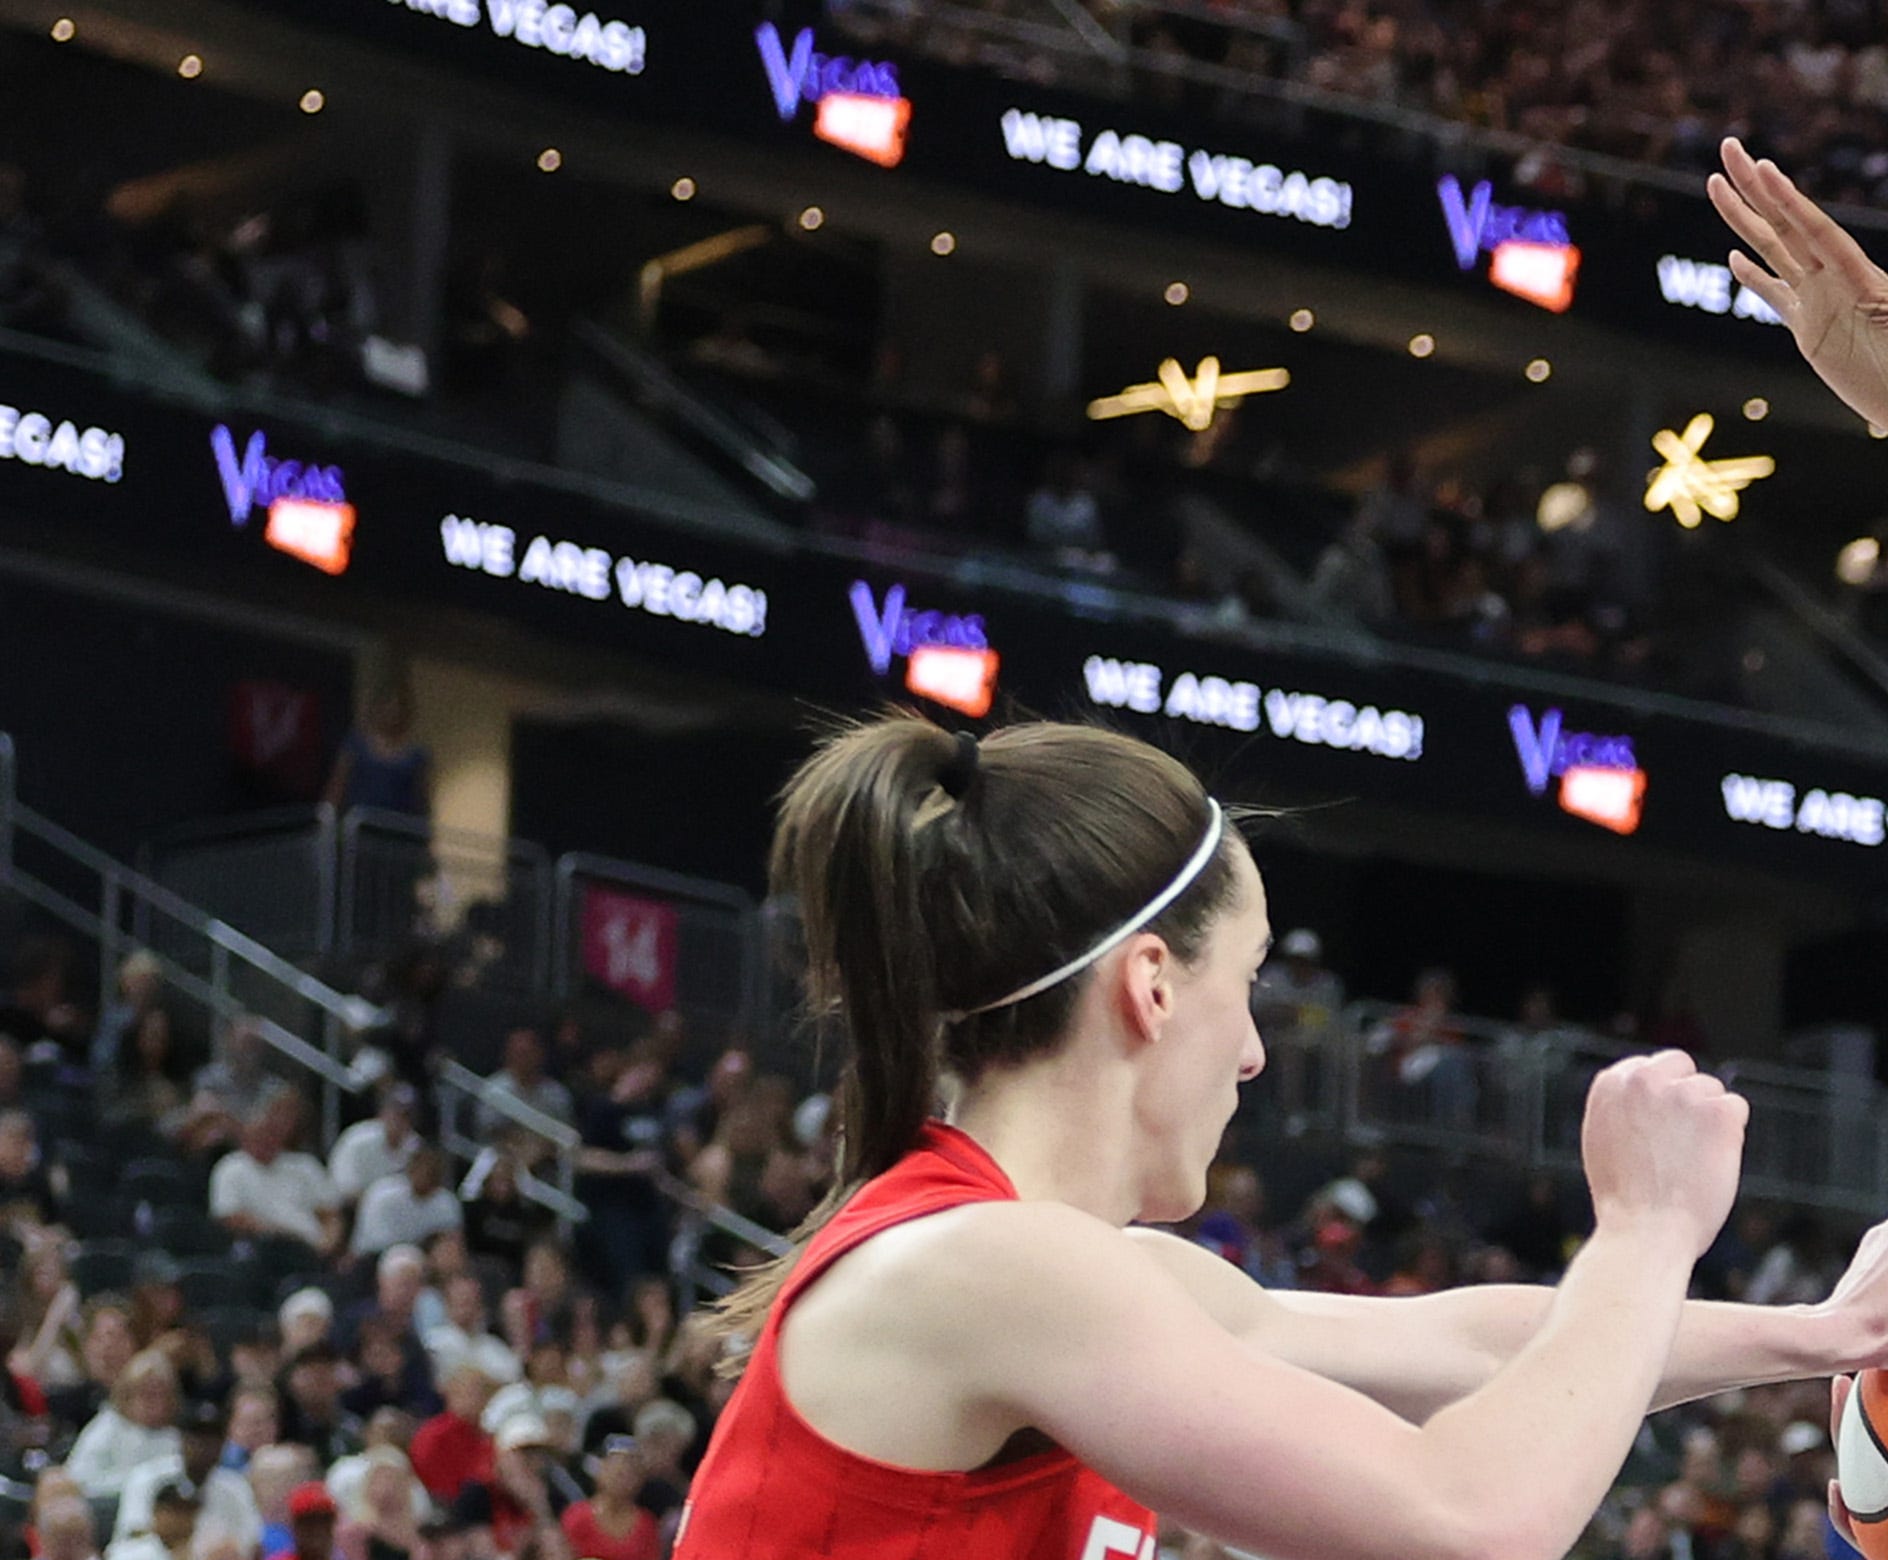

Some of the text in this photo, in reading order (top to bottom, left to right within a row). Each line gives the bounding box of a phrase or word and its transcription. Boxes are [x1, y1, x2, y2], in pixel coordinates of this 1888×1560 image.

[1001, 108, 1352, 230] WE ARE VEGAS!
[1657, 255, 1732, 314] WE
[0, 404, 125, 483] EGAS!
[440, 514, 767, 637] WE ARE VEGAS!
[1083, 655, 1424, 760] WE ARE VEGAS!
[1721, 773, 1796, 830] WE
[1796, 788, 1885, 846] ARE
